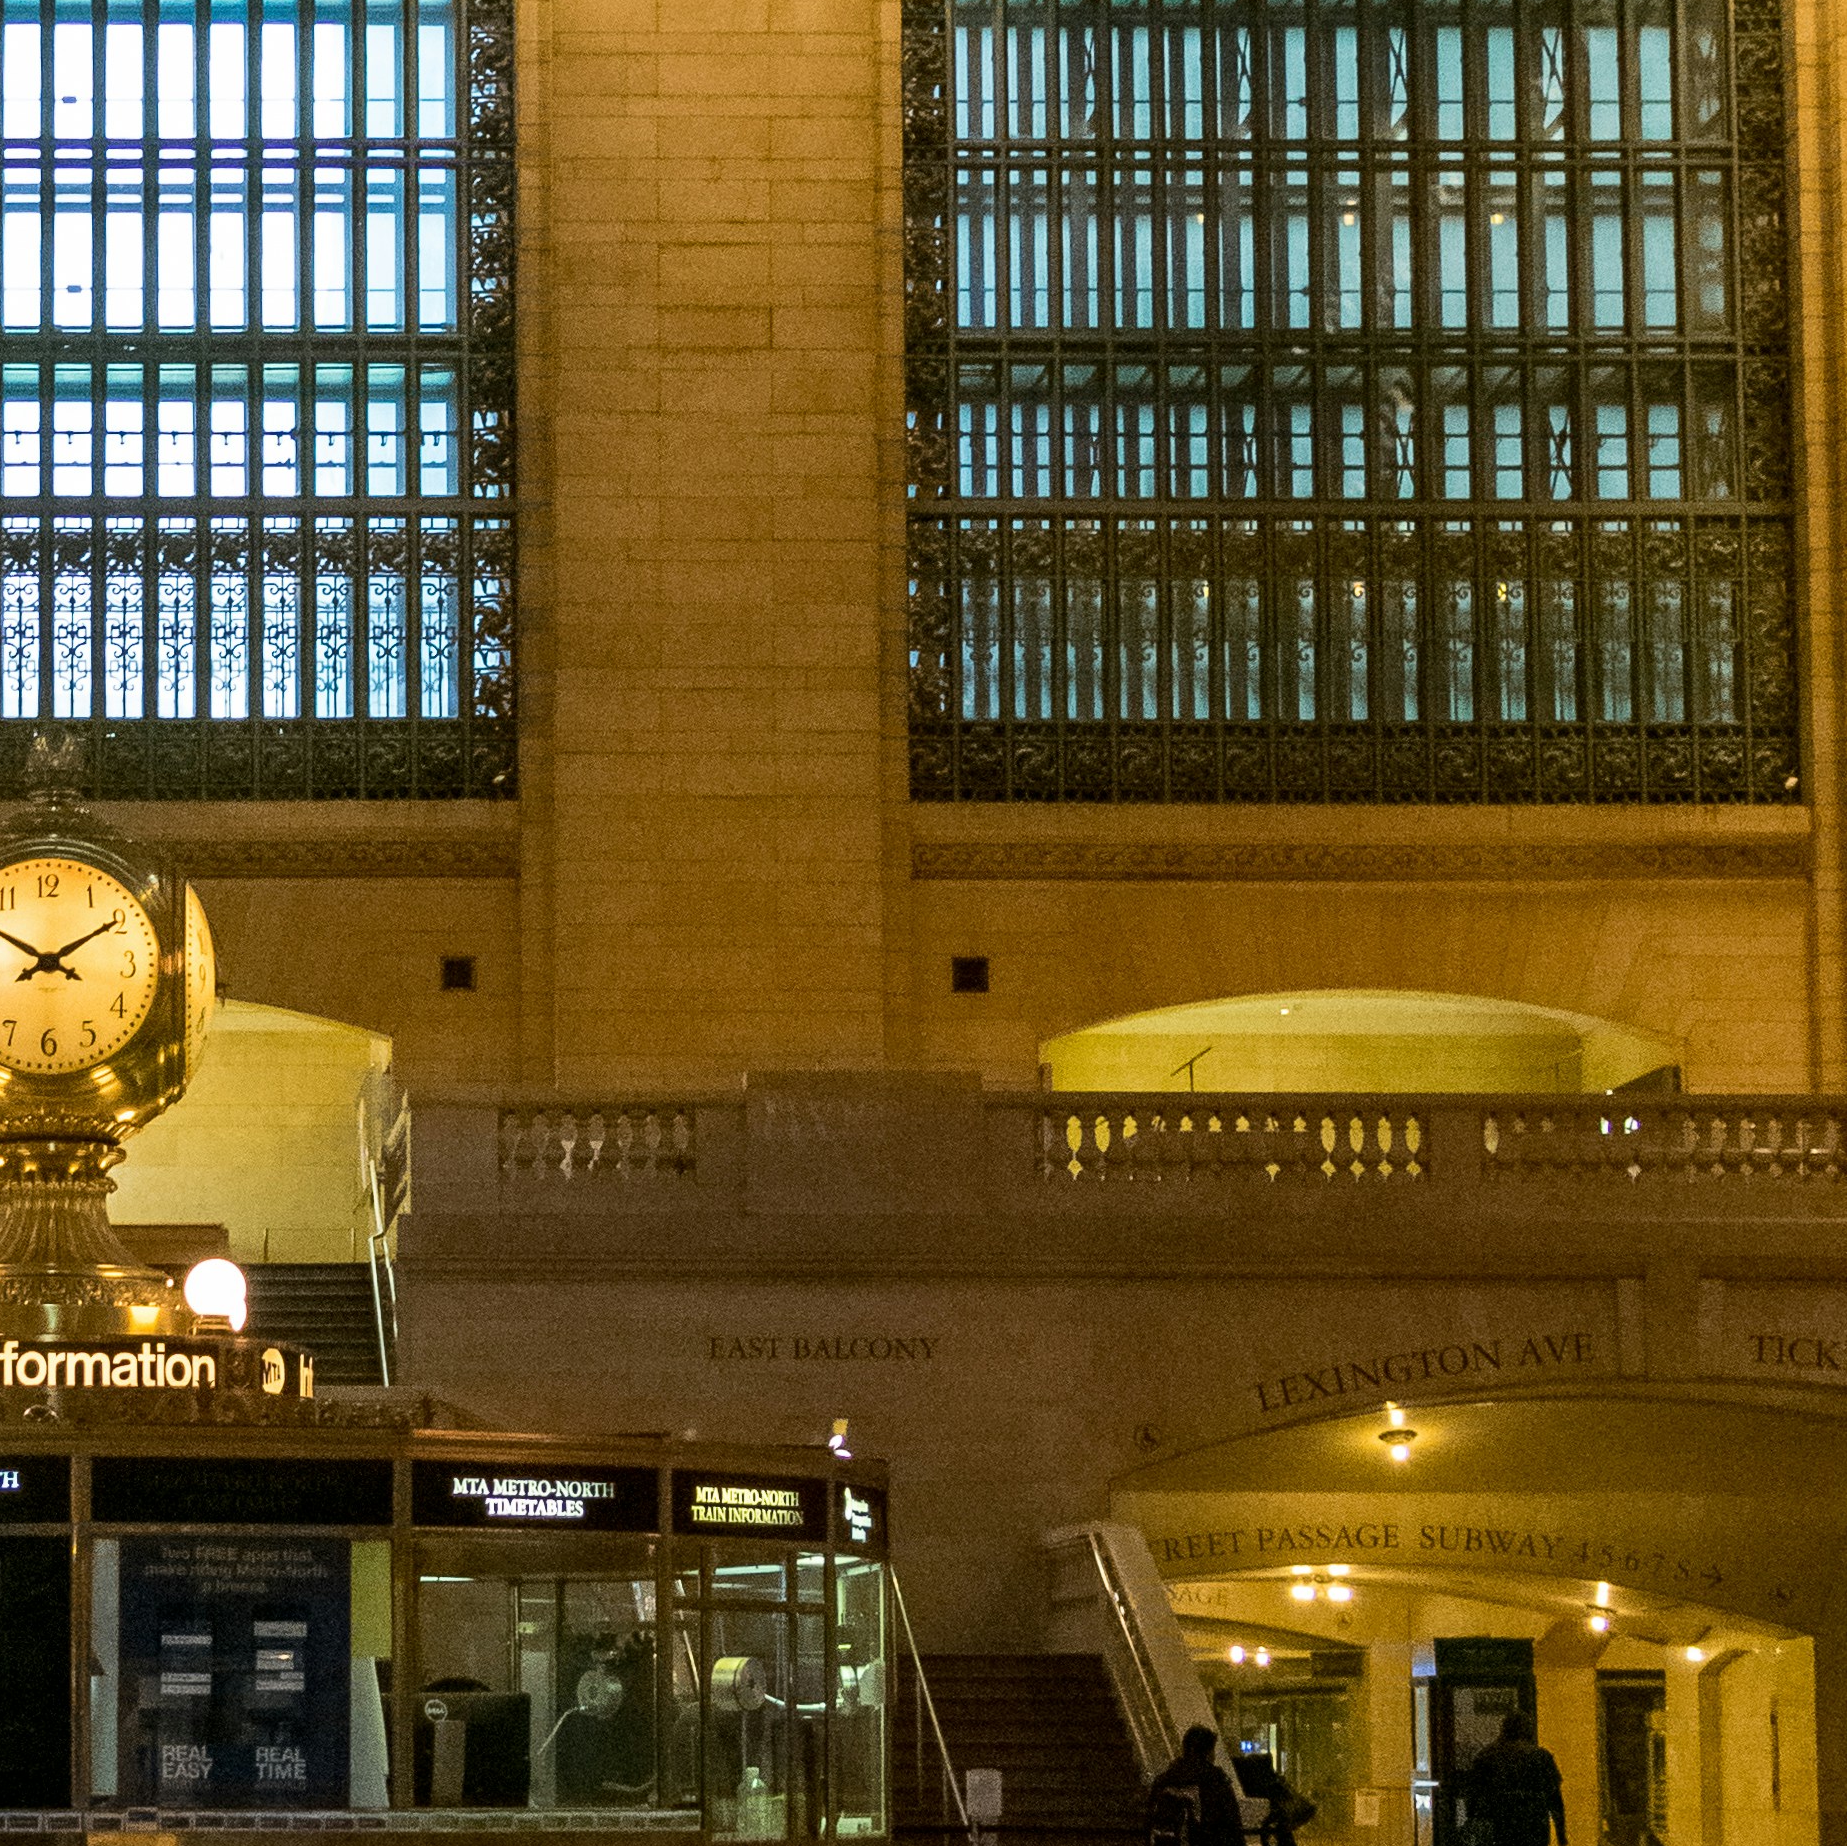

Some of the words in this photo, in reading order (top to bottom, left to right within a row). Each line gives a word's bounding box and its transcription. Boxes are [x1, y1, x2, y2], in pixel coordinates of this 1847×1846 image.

[37, 873, 59, 898] 12
[86, 884, 94, 908] 1
[0, 886, 15, 911] 11
[111, 908, 127, 935] 2
[120, 950, 136, 979] 3
[110, 991, 127, 1019] 4
[2, 1019, 17, 1046] 7
[40, 1028, 57, 1056] 6
[80, 1020, 96, 1048] 5
[709, 1336, 780, 1359] EAST
[792, 1336, 940, 1360] BALCONY
[1256, 1339, 1503, 1413] LEXINGTON
[1513, 1332, 1594, 1365] AVE
[453, 1478, 489, 1495] MTA
[493, 1479, 615, 1498] METRO-NORTH
[696, 1486, 720, 1503] MTA
[721, 1487, 799, 1507] METRO-NORTH
[485, 1498, 585, 1517] TIMETABLES
[691, 1506, 726, 1522] TRAIN
[728, 1507, 804, 1526] INFORMATION
[1255, 1524, 1400, 1552] PASSAGE
[1419, 1525, 1564, 1559] SUBWAY
[162, 1745, 212, 1761] REAL
[256, 1746, 305, 1762] REAL
[162, 1762, 213, 1779] EASY
[256, 1763, 307, 1780] TIME
